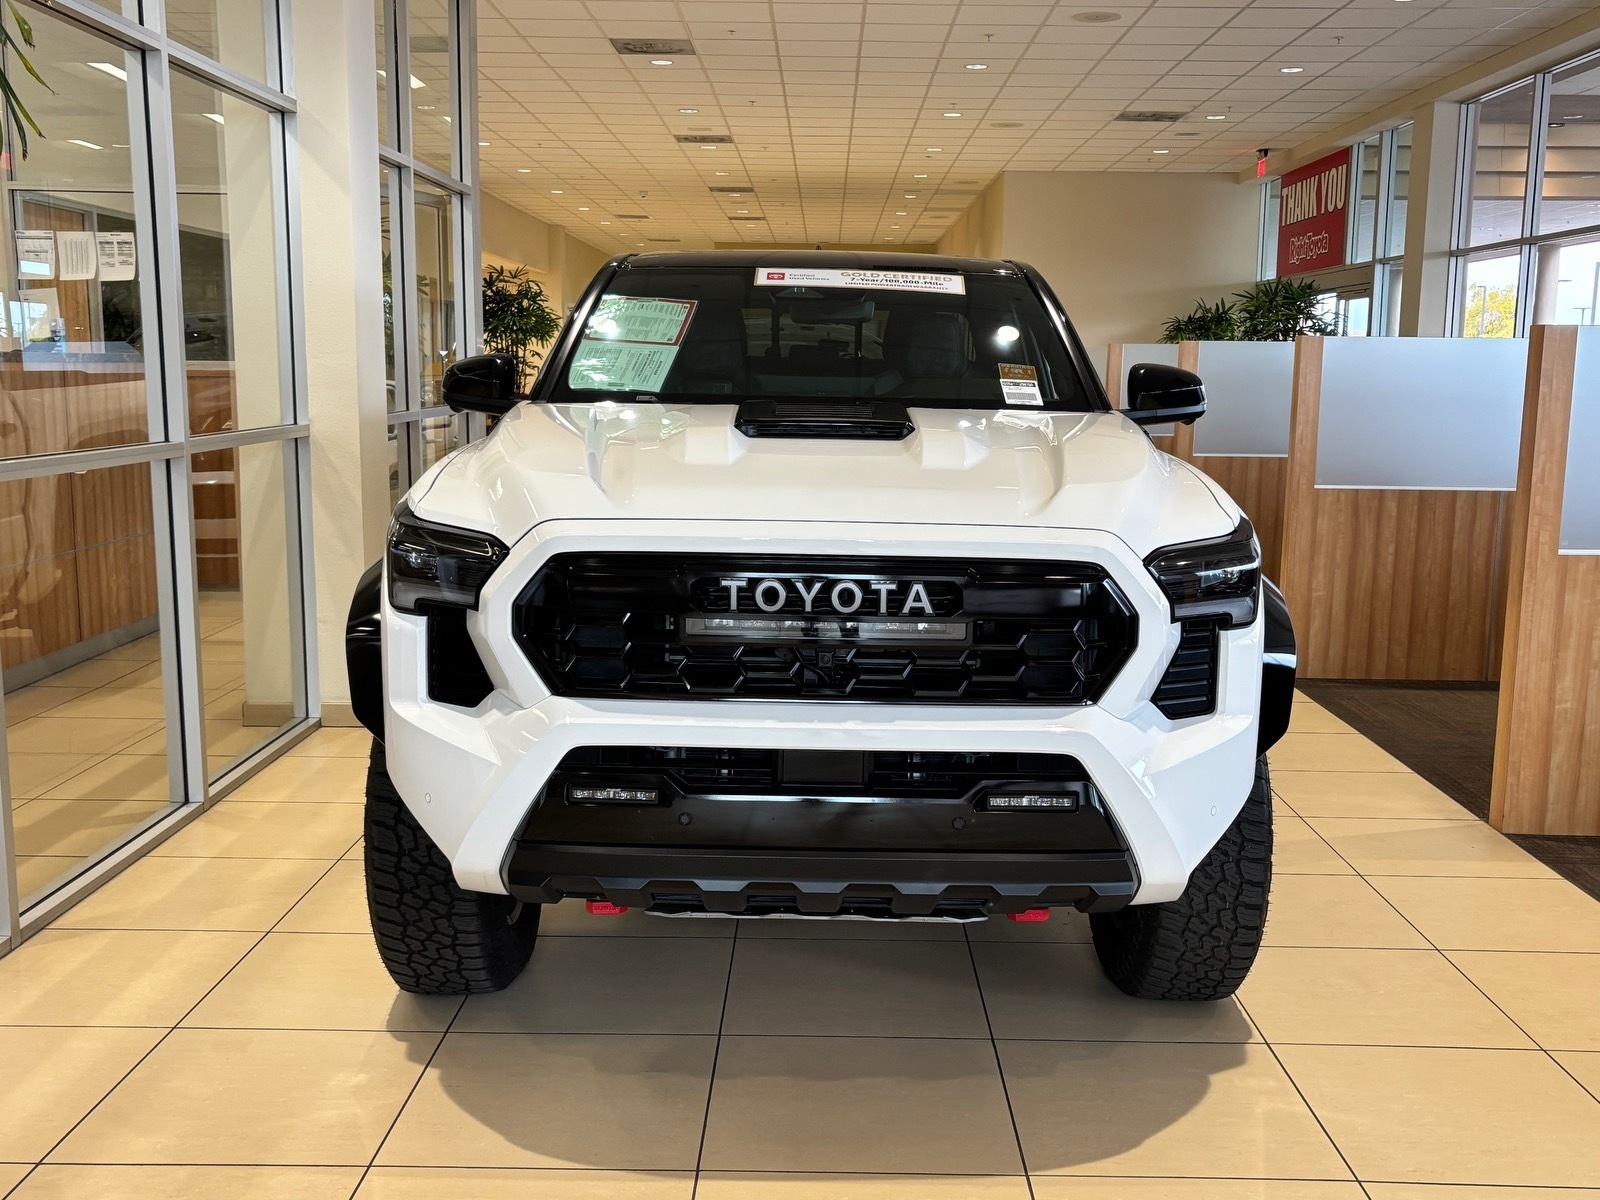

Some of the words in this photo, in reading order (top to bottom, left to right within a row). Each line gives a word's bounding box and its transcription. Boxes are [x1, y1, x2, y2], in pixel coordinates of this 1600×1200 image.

[1281, 174, 1319, 227] THANK
[1320, 163, 1347, 214] YOU
[840, 271, 880, 279] GOLD
[883, 273, 953, 283] CERTIFIED
[850, 277, 944, 286] 7-Year/100,000-Mile
[719, 577, 936, 616] TOYOTA
